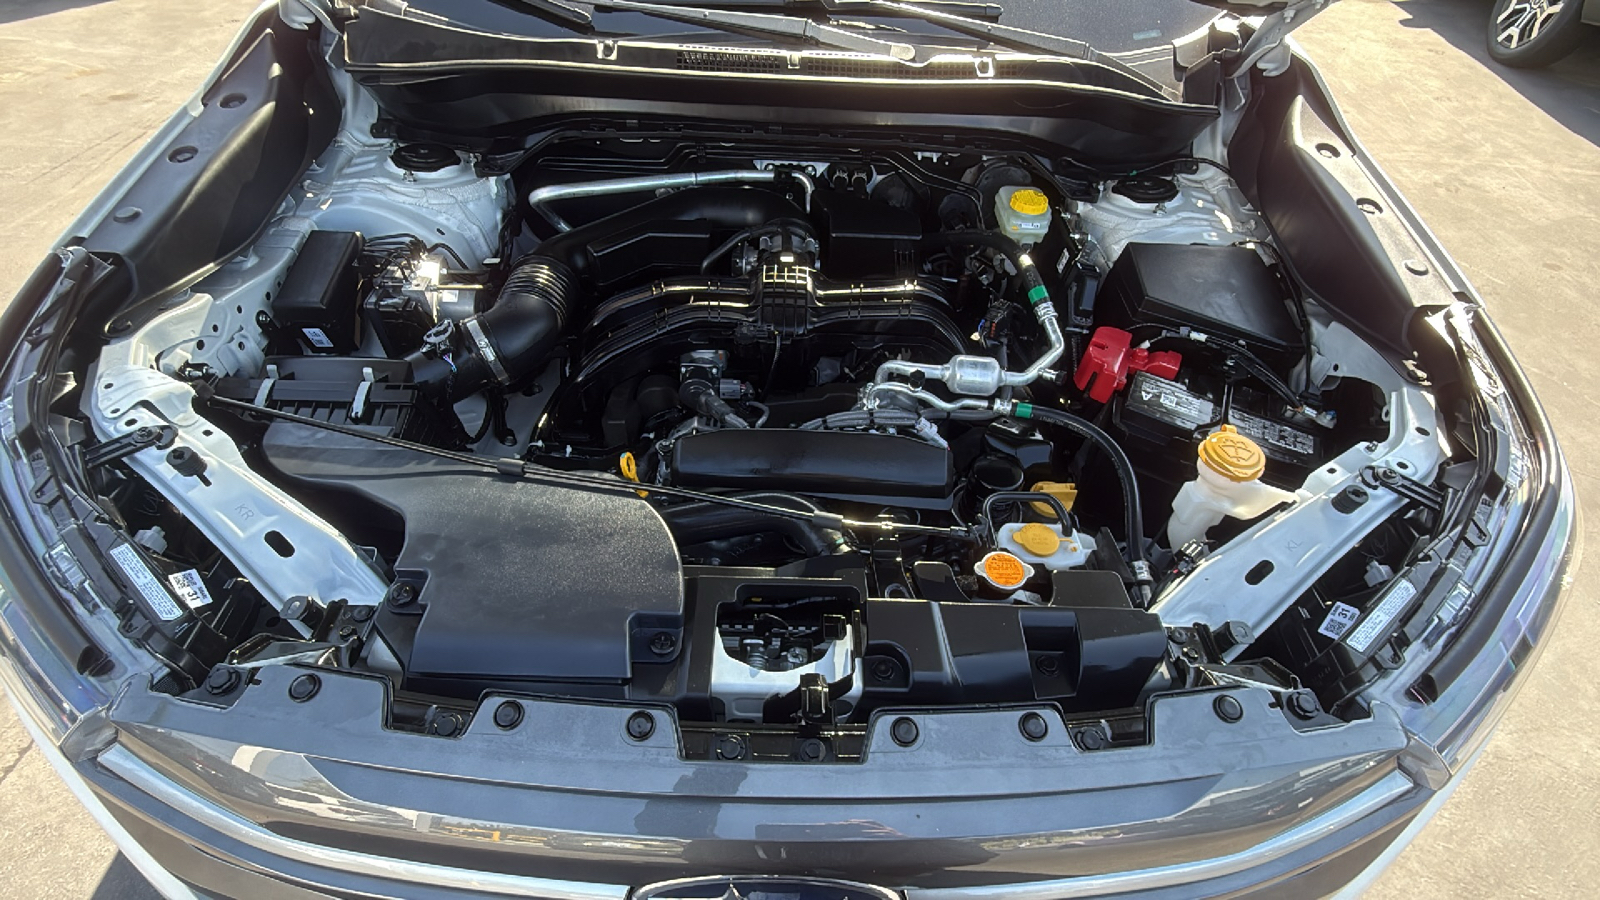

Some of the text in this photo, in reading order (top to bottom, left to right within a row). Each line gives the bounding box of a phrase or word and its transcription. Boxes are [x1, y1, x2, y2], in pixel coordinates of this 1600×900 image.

[234, 503, 255, 521] KR
[187, 591, 200, 601] 31
[1338, 608, 1350, 619] 31
